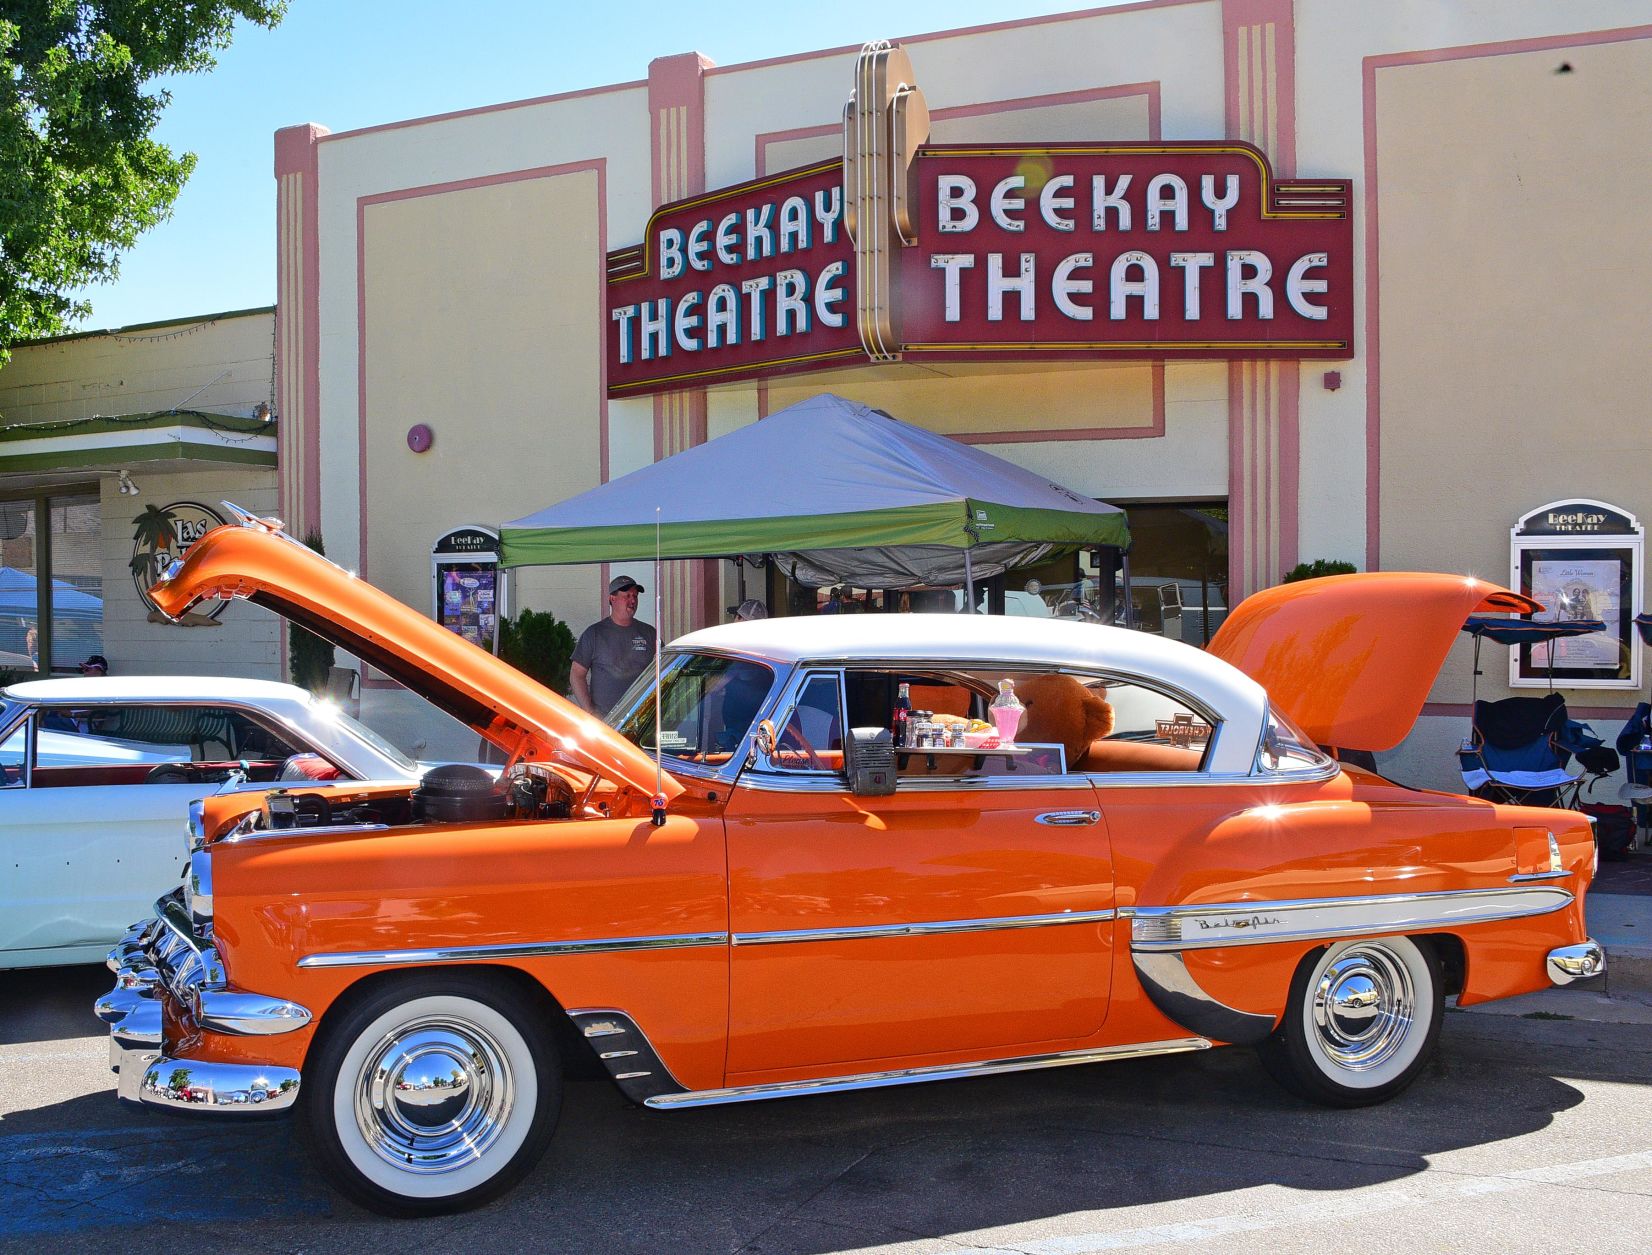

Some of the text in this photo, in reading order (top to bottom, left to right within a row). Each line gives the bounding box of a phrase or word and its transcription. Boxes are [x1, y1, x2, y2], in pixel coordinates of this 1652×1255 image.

[660, 186, 842, 280] BEEKAY
[938, 173, 1240, 233] BEEKAY
[612, 260, 848, 363] THEATRE
[930, 250, 1329, 322] THEATRE
[1548, 512, 1608, 524] BeeKay
[653, 799, 664, 807] 76
